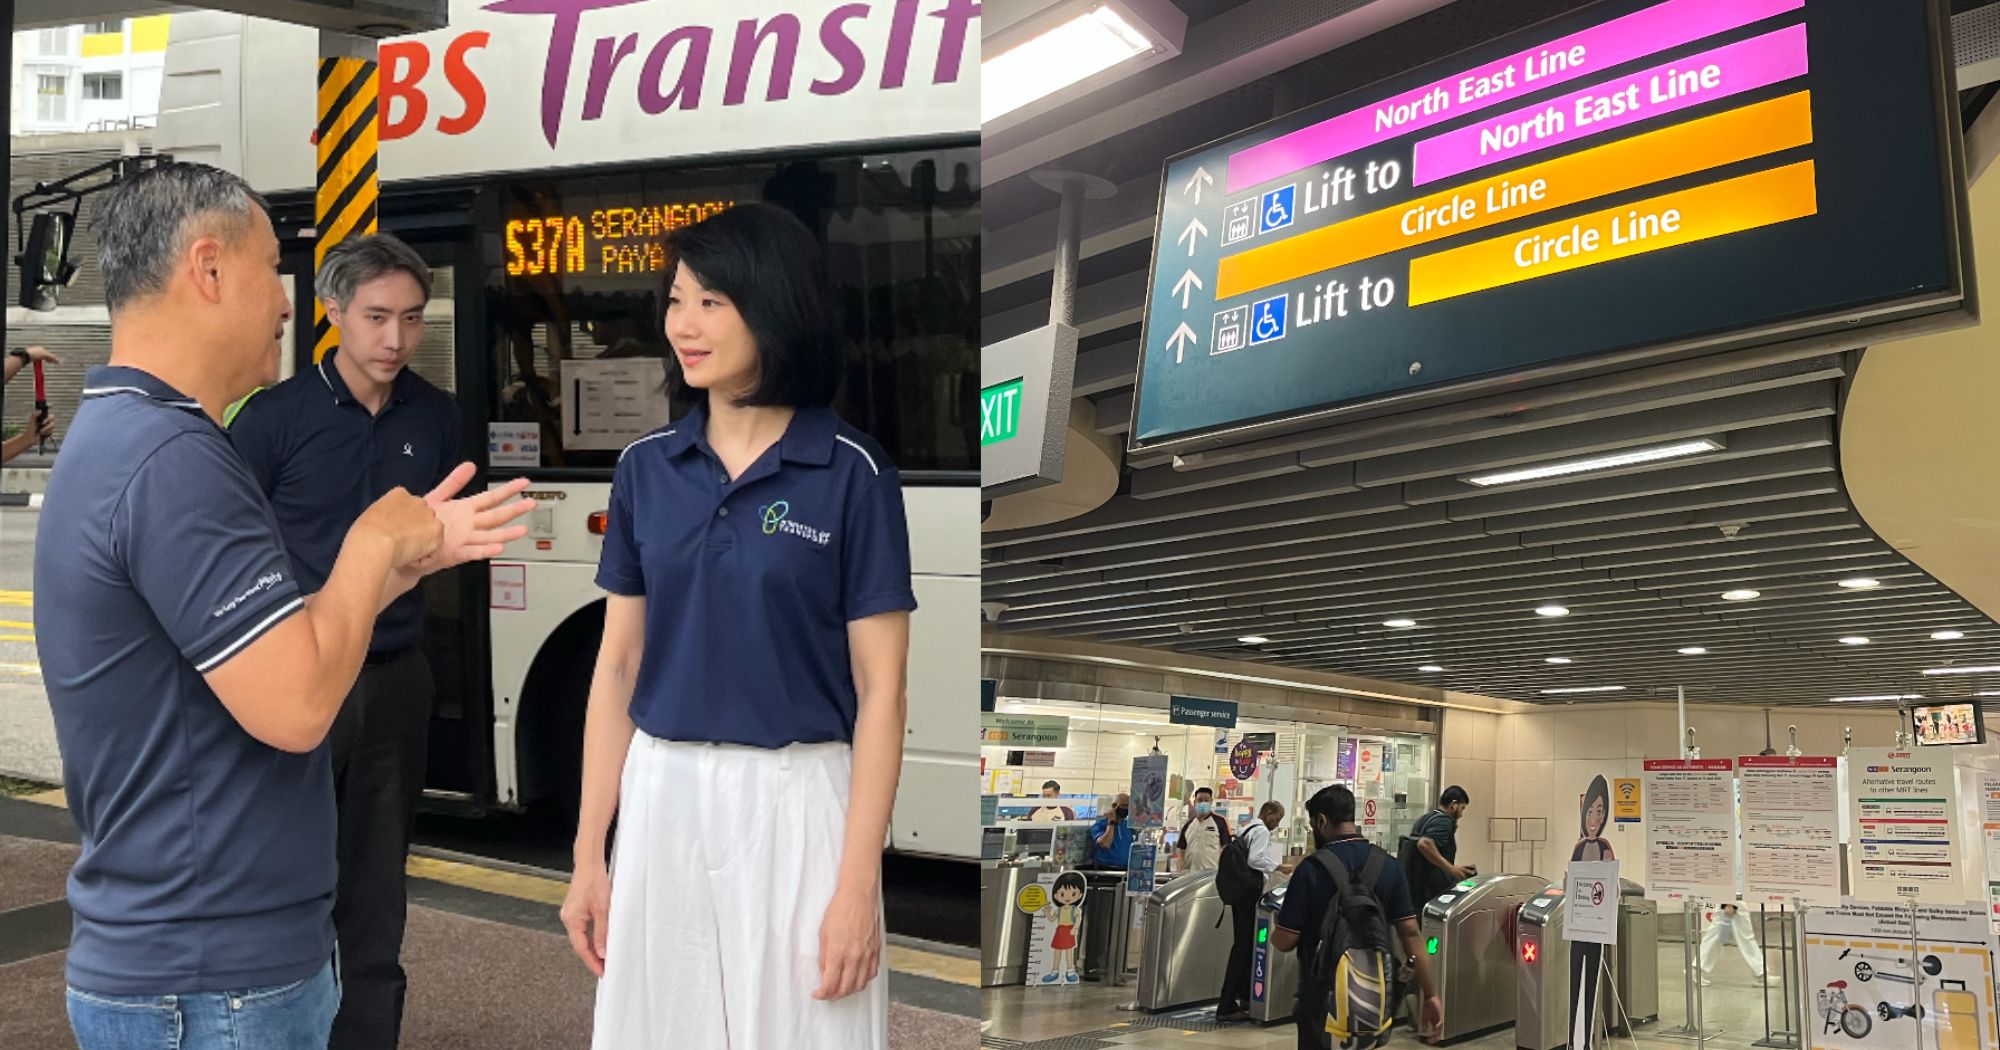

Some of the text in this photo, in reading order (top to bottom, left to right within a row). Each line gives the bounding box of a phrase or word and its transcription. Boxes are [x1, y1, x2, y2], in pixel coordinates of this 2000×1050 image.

[311, 0, 982, 150] BS Transit
[1375, 45, 1585, 132] North East Line
[1303, 64, 1720, 215] Lift to North East Line
[591, 201, 735, 239] SERANGO
[1401, 178, 1547, 236] Circle Line
[506, 216, 585, 276] S37A
[602, 243, 667, 274] PAYA
[1296, 208, 1681, 328] Lift to Circle Line
[981, 388, 1018, 441] XIT
[1012, 731, 1058, 741] Serangoon
[1181, 706, 1231, 719] Passenger service
[1891, 765, 1932, 774] Serangoon
